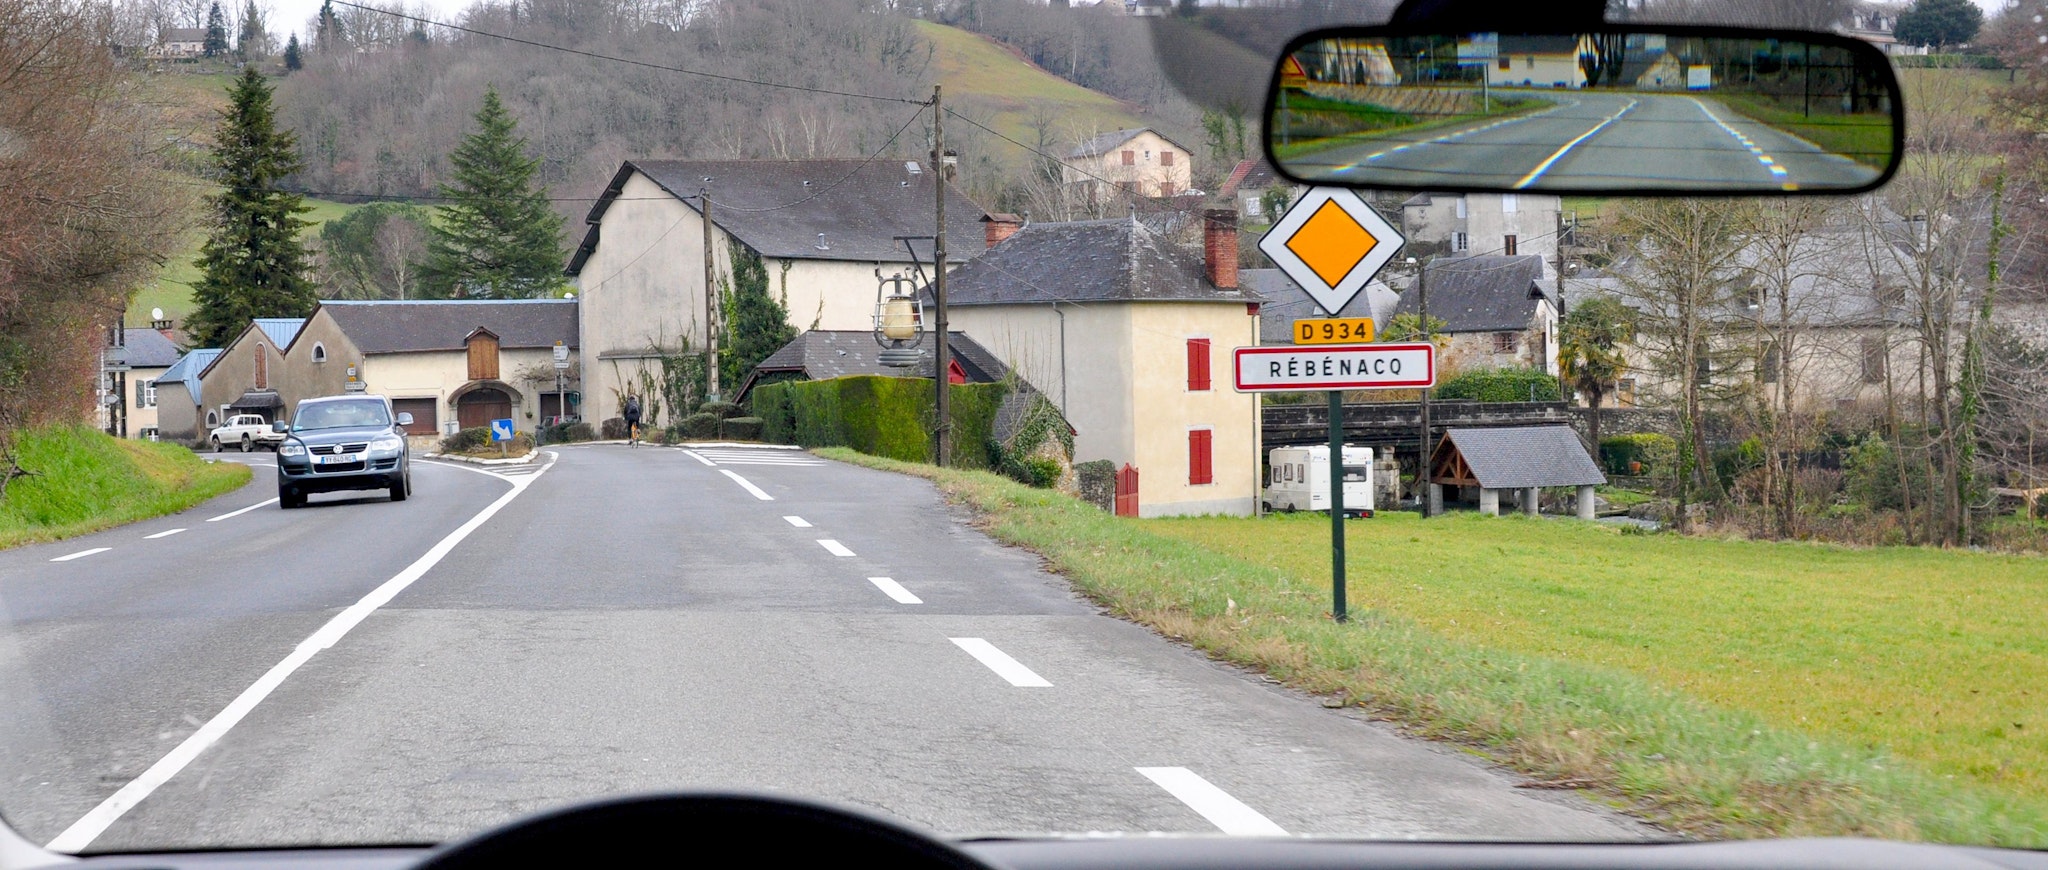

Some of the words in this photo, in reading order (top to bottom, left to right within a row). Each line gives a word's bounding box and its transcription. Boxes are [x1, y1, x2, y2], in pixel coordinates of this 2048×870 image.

[1302, 324, 1313, 340] D
[1322, 322, 1366, 340] 934
[1270, 356, 1401, 377] RÉBÉNACQ
